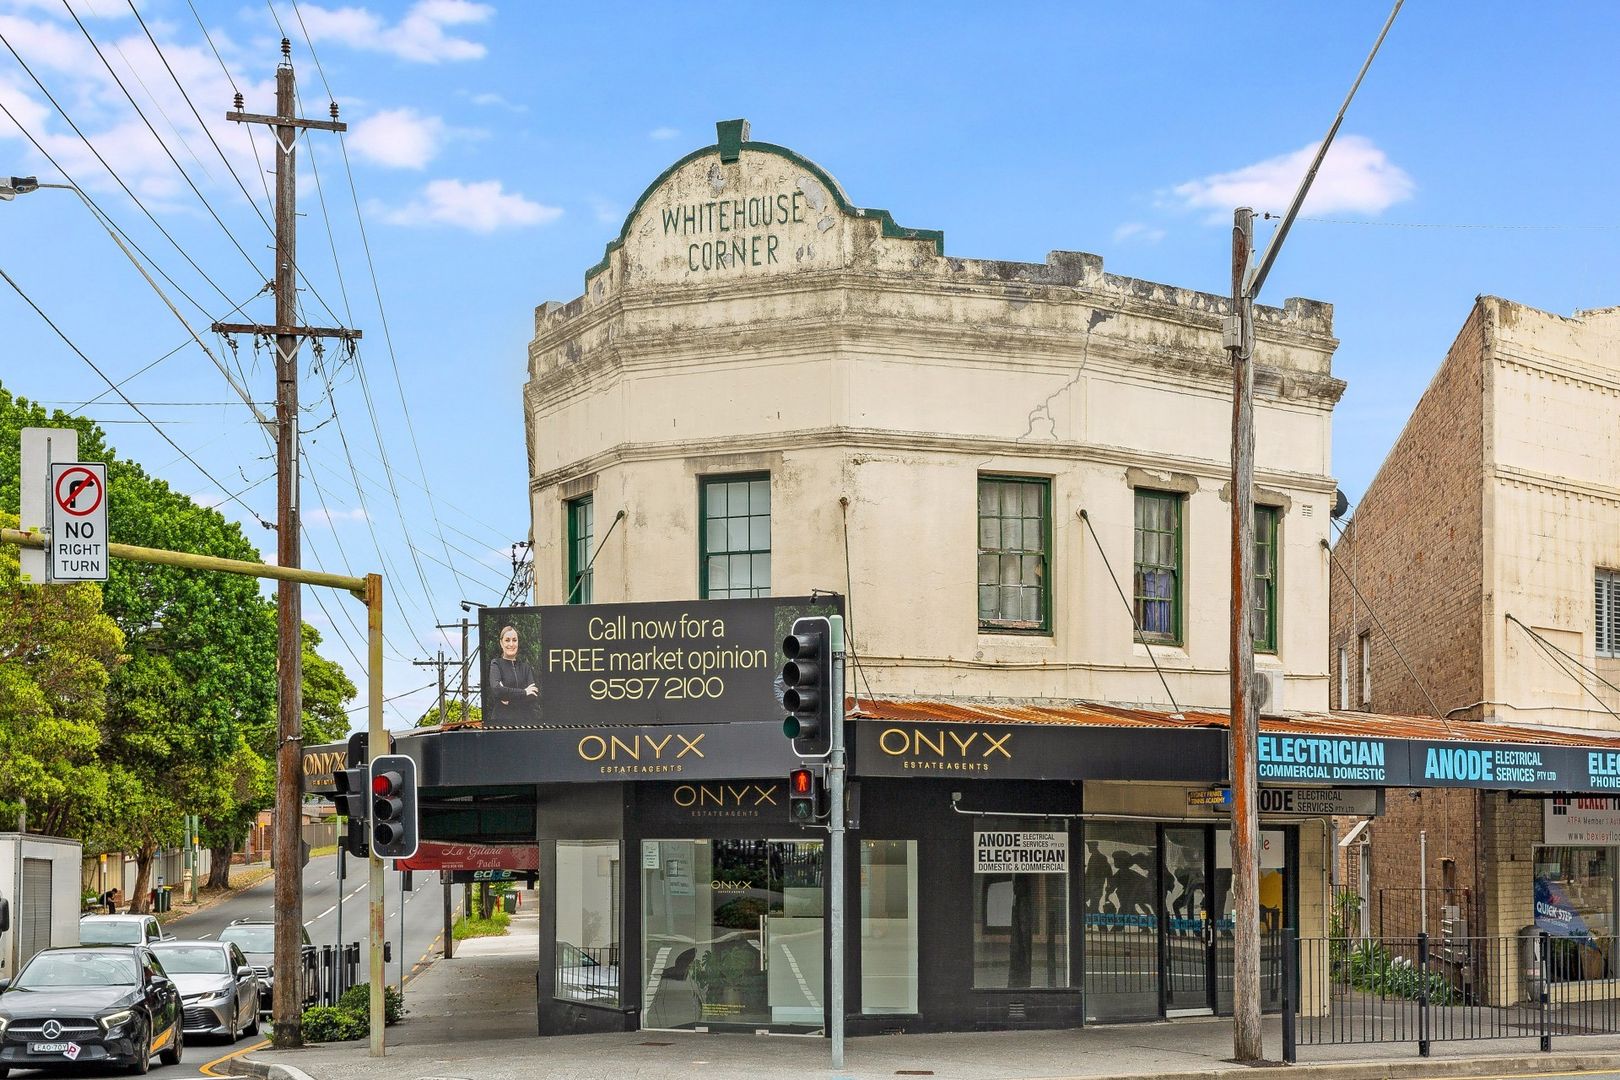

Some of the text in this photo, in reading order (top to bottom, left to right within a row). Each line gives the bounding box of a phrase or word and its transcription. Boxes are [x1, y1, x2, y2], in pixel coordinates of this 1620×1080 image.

[662, 190, 805, 236] WHITEHOUSE
[688, 235, 779, 272] CORNER
[65, 522, 94, 539] NO
[59, 544, 101, 555] RIGHT
[61, 560, 100, 572] TURN
[588, 613, 725, 641] Call now for a
[549, 644, 767, 675] FREE market opinion
[589, 676, 724, 700] 9597 2100
[578, 733, 706, 762] ONYX
[879, 728, 1012, 759] ONYX
[1257, 736, 1385, 766] ELECTRICIAN
[303, 751, 347, 776] ONYX
[600, 764, 683, 773] ESTATE AGENTS
[904, 761, 989, 771] ESTATE AGENTS
[1425, 748, 1543, 781] ANODE ELECTRICAL
[1259, 764, 1386, 780] COMMERCIAL DOMESTIC
[1496, 767, 1557, 782] SERVICES PTY LTD
[673, 785, 777, 807] ONYX
[1257, 789, 1343, 812] ODE ELECTRICAL
[1297, 802, 1334, 813] SERVICES
[978, 833, 1055, 847] ANODE ELECTRICAL
[441, 845, 464, 856] La
[978, 849, 1065, 863] ELECTRICIAN
[476, 859, 502, 868] Paella
[978, 863, 1013, 871] DOMESTIC
[1020, 863, 1065, 871] COMMERCIAL
[710, 880, 752, 890] ONYX
[67, 1046, 77, 1055] P
